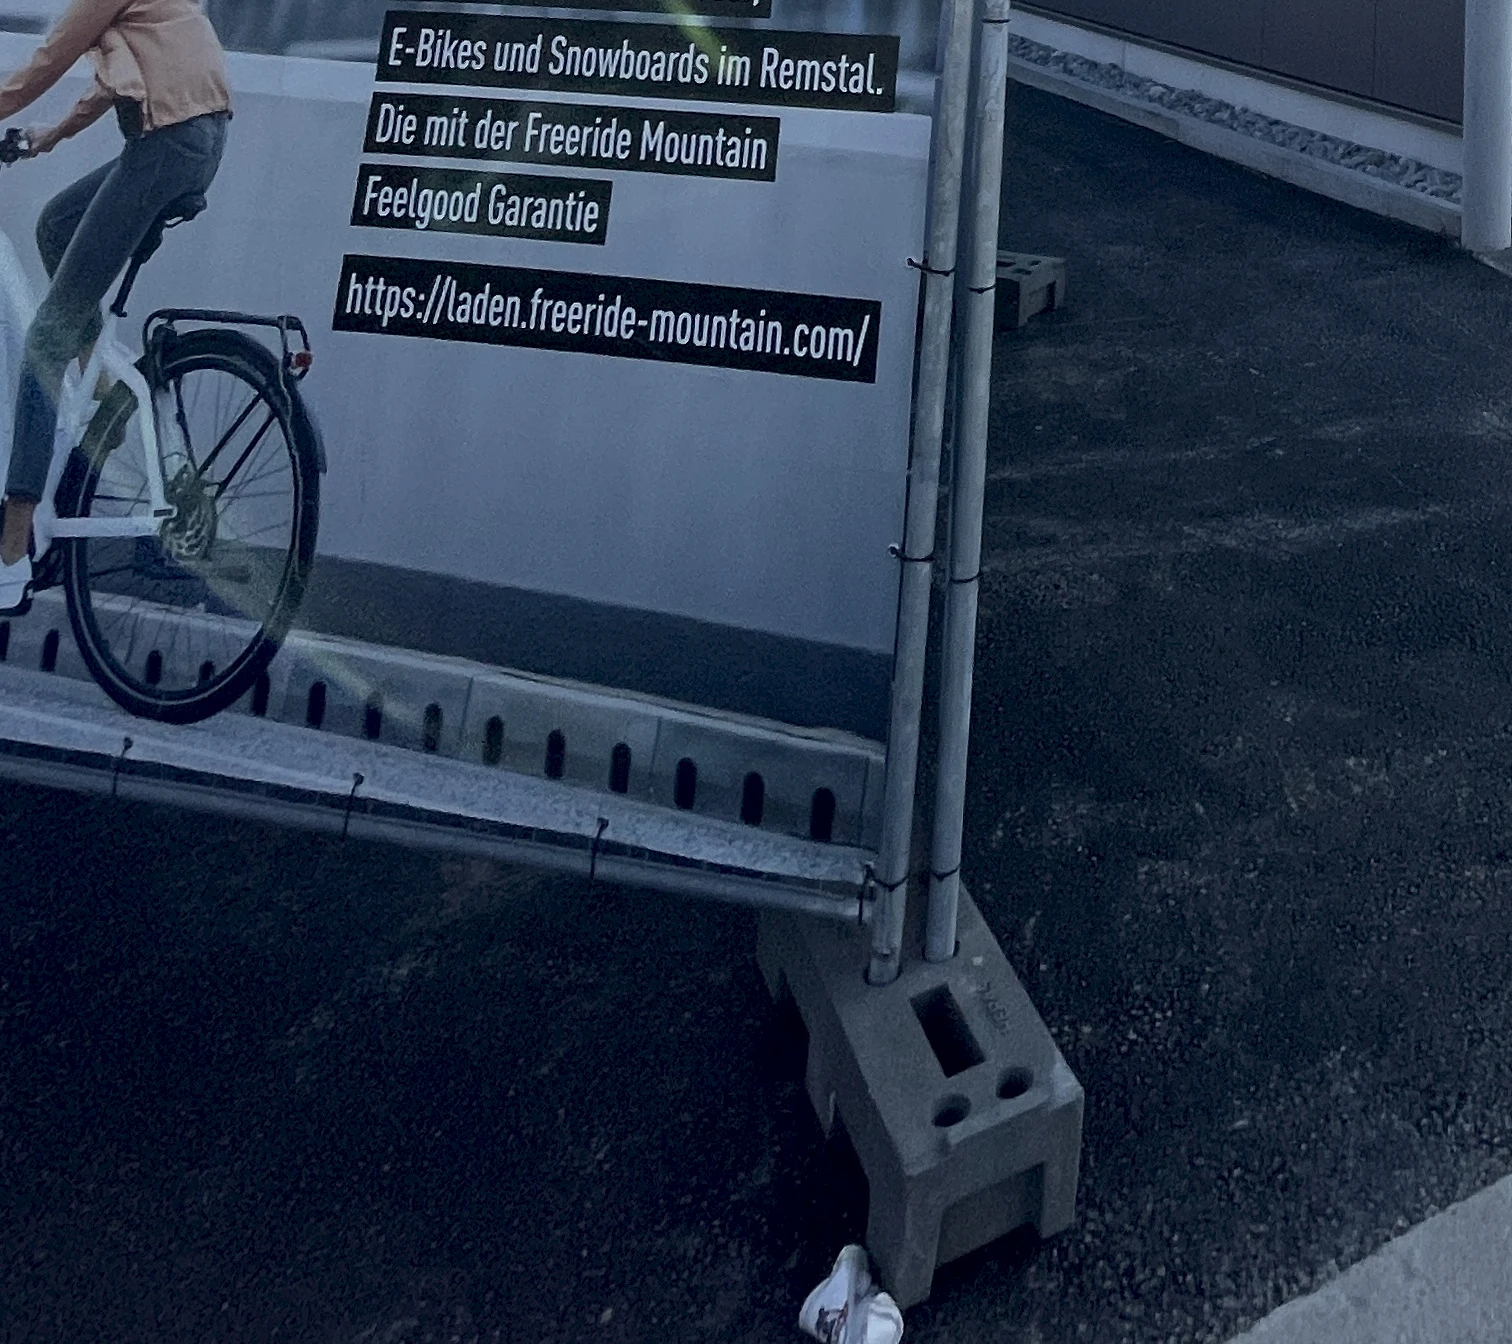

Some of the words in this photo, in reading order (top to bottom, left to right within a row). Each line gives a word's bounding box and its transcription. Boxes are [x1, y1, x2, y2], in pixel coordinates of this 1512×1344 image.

[388, 26, 487, 71] E-Bikes
[493, 29, 542, 75] und
[547, 34, 709, 87] Snowboards
[716, 45, 751, 88] im
[759, 46, 885, 97] Remstal.
[374, 103, 416, 145] Die
[422, 108, 469, 150] mit
[473, 109, 519, 152] der
[522, 112, 632, 161] Freeride
[639, 122, 768, 171] Mountain
[362, 174, 481, 231] Feelgood
[487, 183, 600, 235] Garantie
[343, 272, 871, 367] https://laden.freeride-mountain.com/
